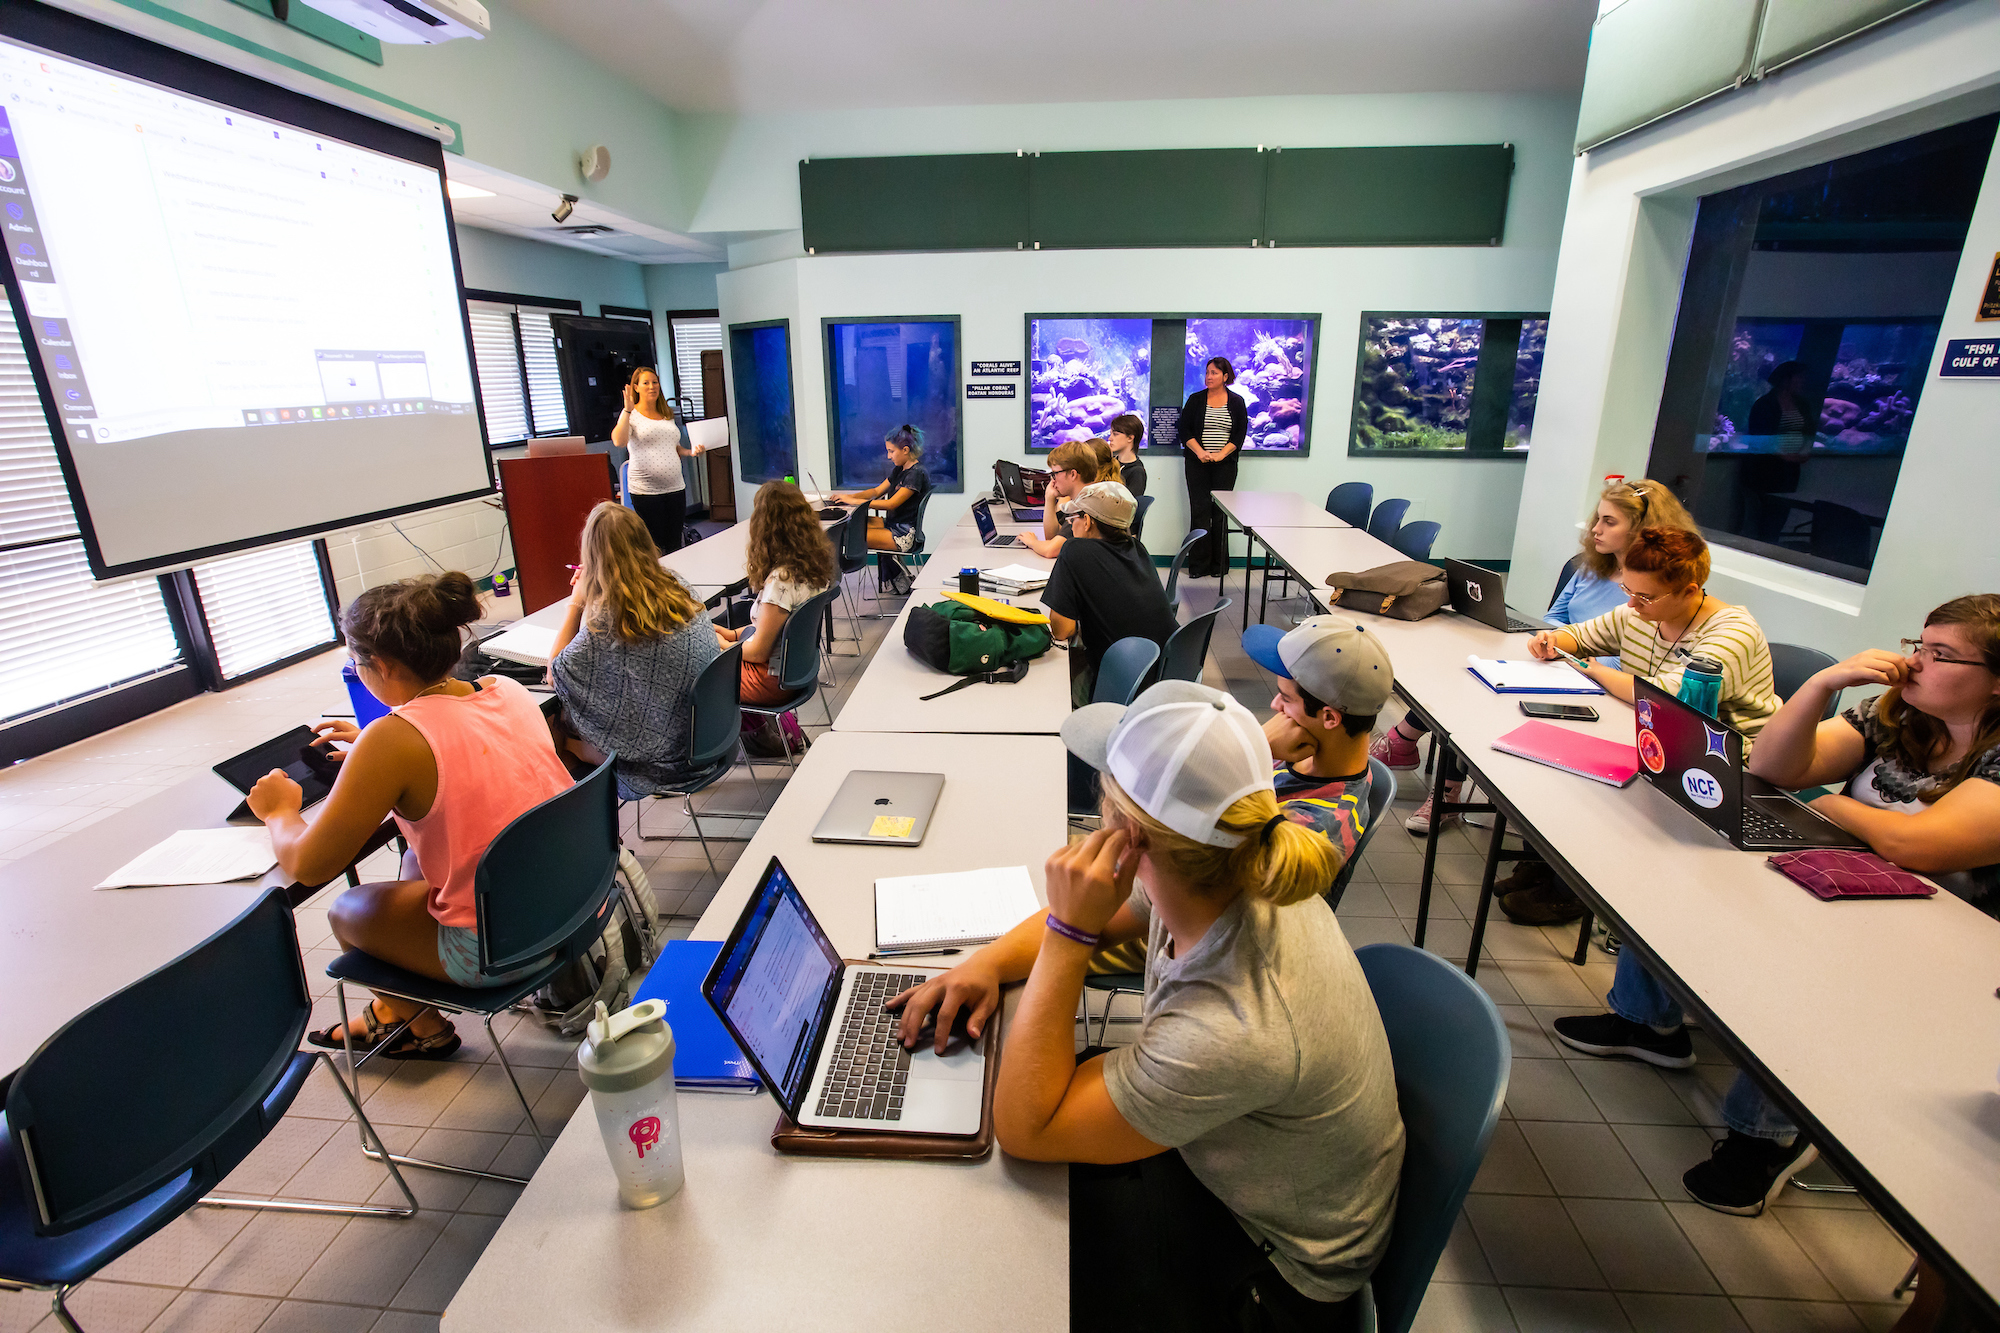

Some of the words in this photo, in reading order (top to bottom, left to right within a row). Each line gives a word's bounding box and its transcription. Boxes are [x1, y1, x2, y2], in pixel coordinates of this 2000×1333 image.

[9, 222, 34, 233] Admin
[15, 257, 48, 268] Dashboa
[1964, 344, 1995, 354] "FISH
[1952, 357, 1980, 367] GULF
[1983, 357, 1999, 367] OF
[1687, 776, 1715, 796] NCF
